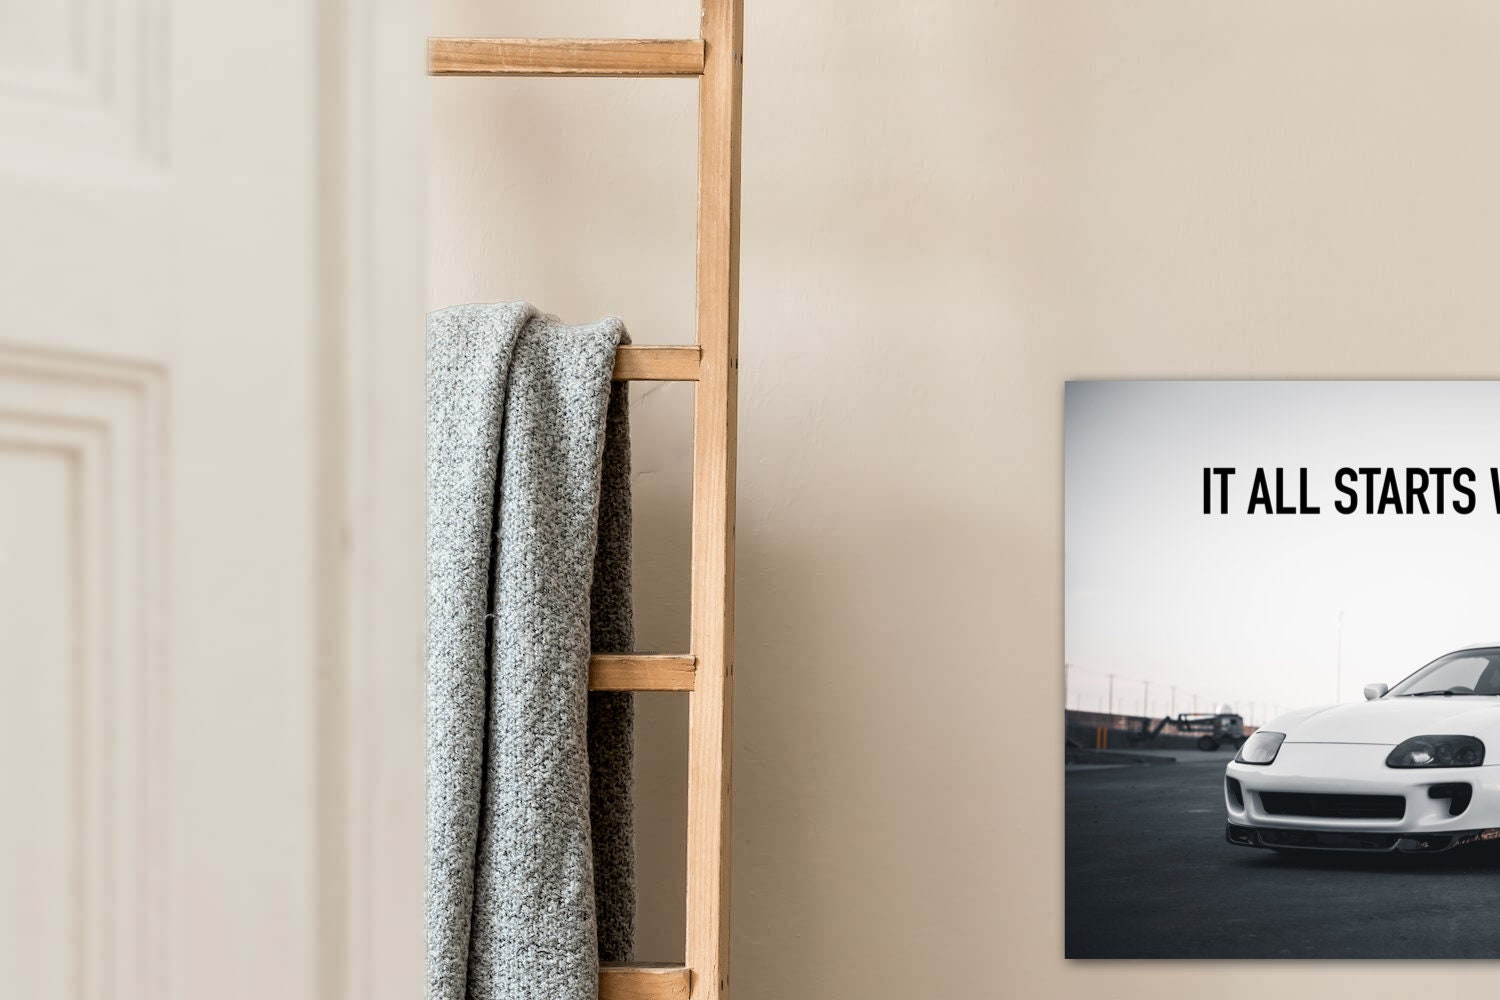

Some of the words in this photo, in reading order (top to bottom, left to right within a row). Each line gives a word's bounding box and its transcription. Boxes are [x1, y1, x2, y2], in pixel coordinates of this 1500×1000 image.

[1203, 467, 1236, 515] IT
[1247, 467, 1321, 515] ALL
[1334, 467, 1476, 515] STARTS
